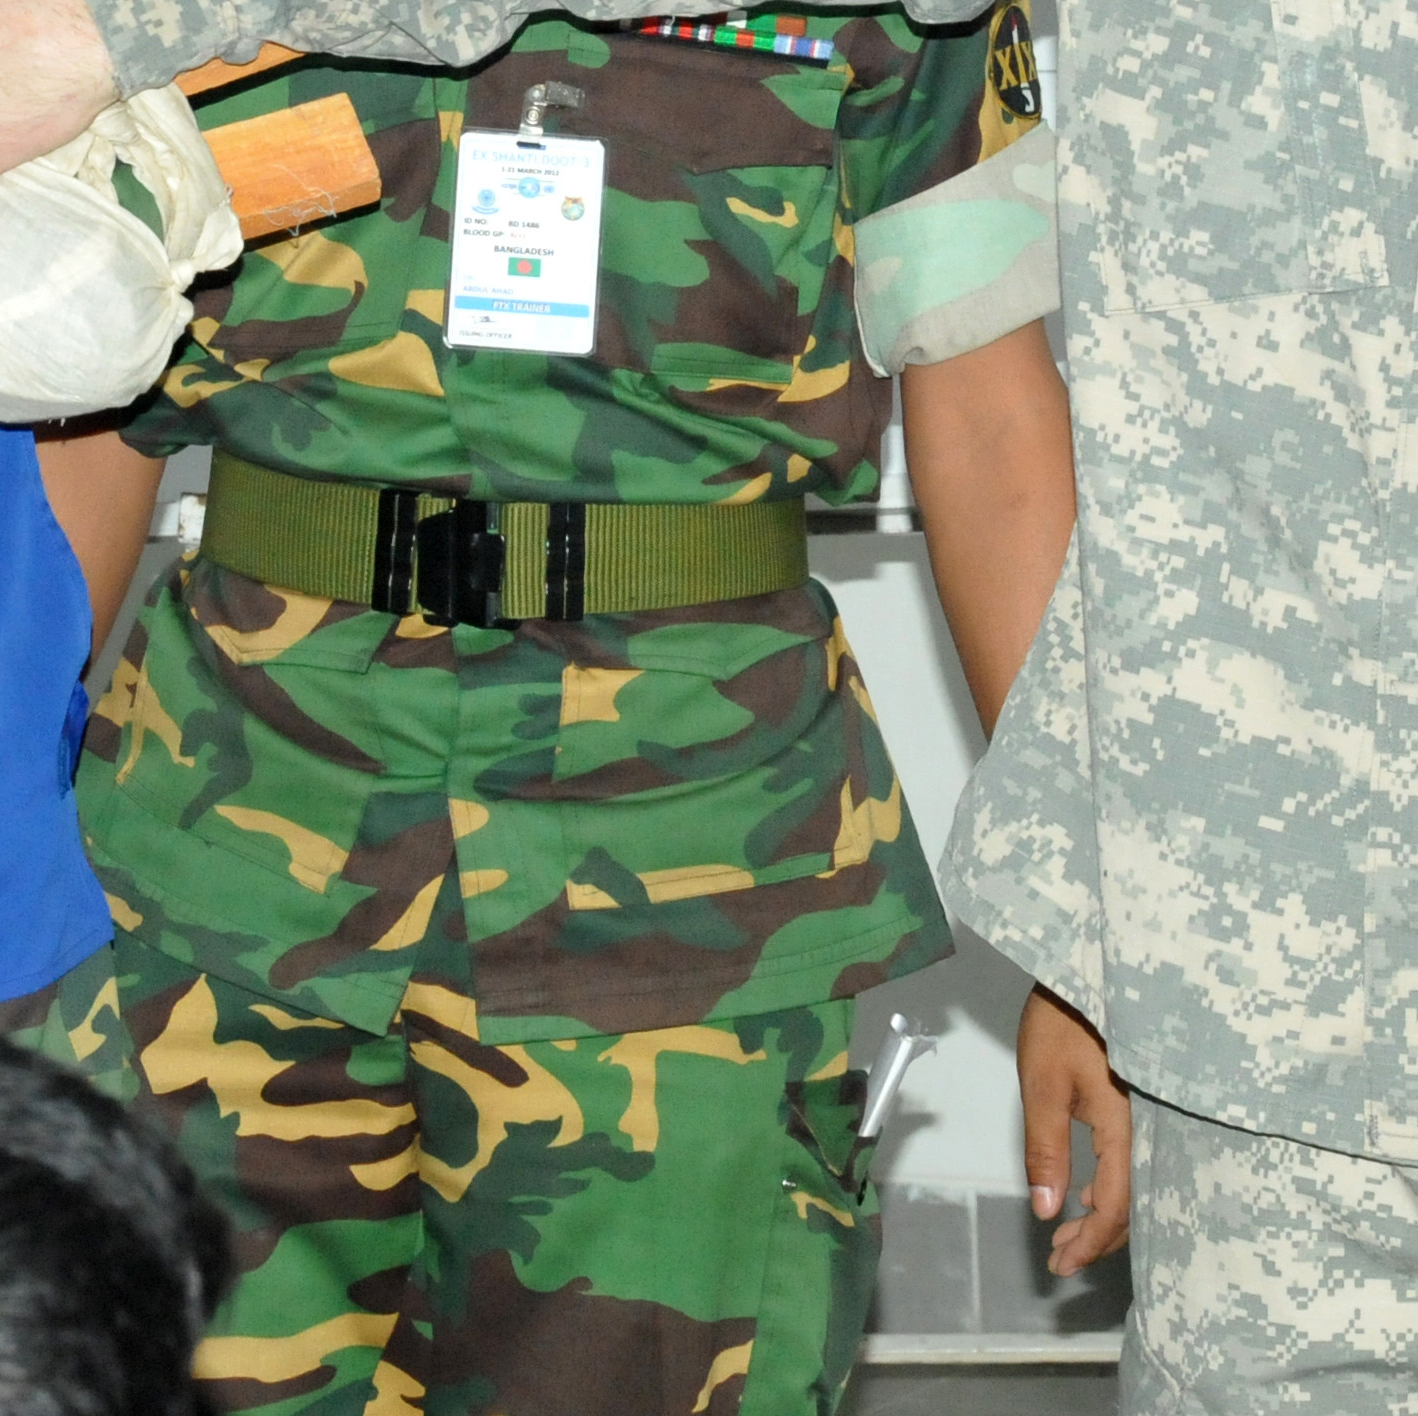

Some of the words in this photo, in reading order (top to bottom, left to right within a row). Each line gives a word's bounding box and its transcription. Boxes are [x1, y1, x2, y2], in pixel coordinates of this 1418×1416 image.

[492, 151, 537, 163] SHANTI
[463, 228, 490, 236] BLOOD
[493, 245, 554, 256] BANGLADESH
[512, 302, 551, 313] TRAINER
